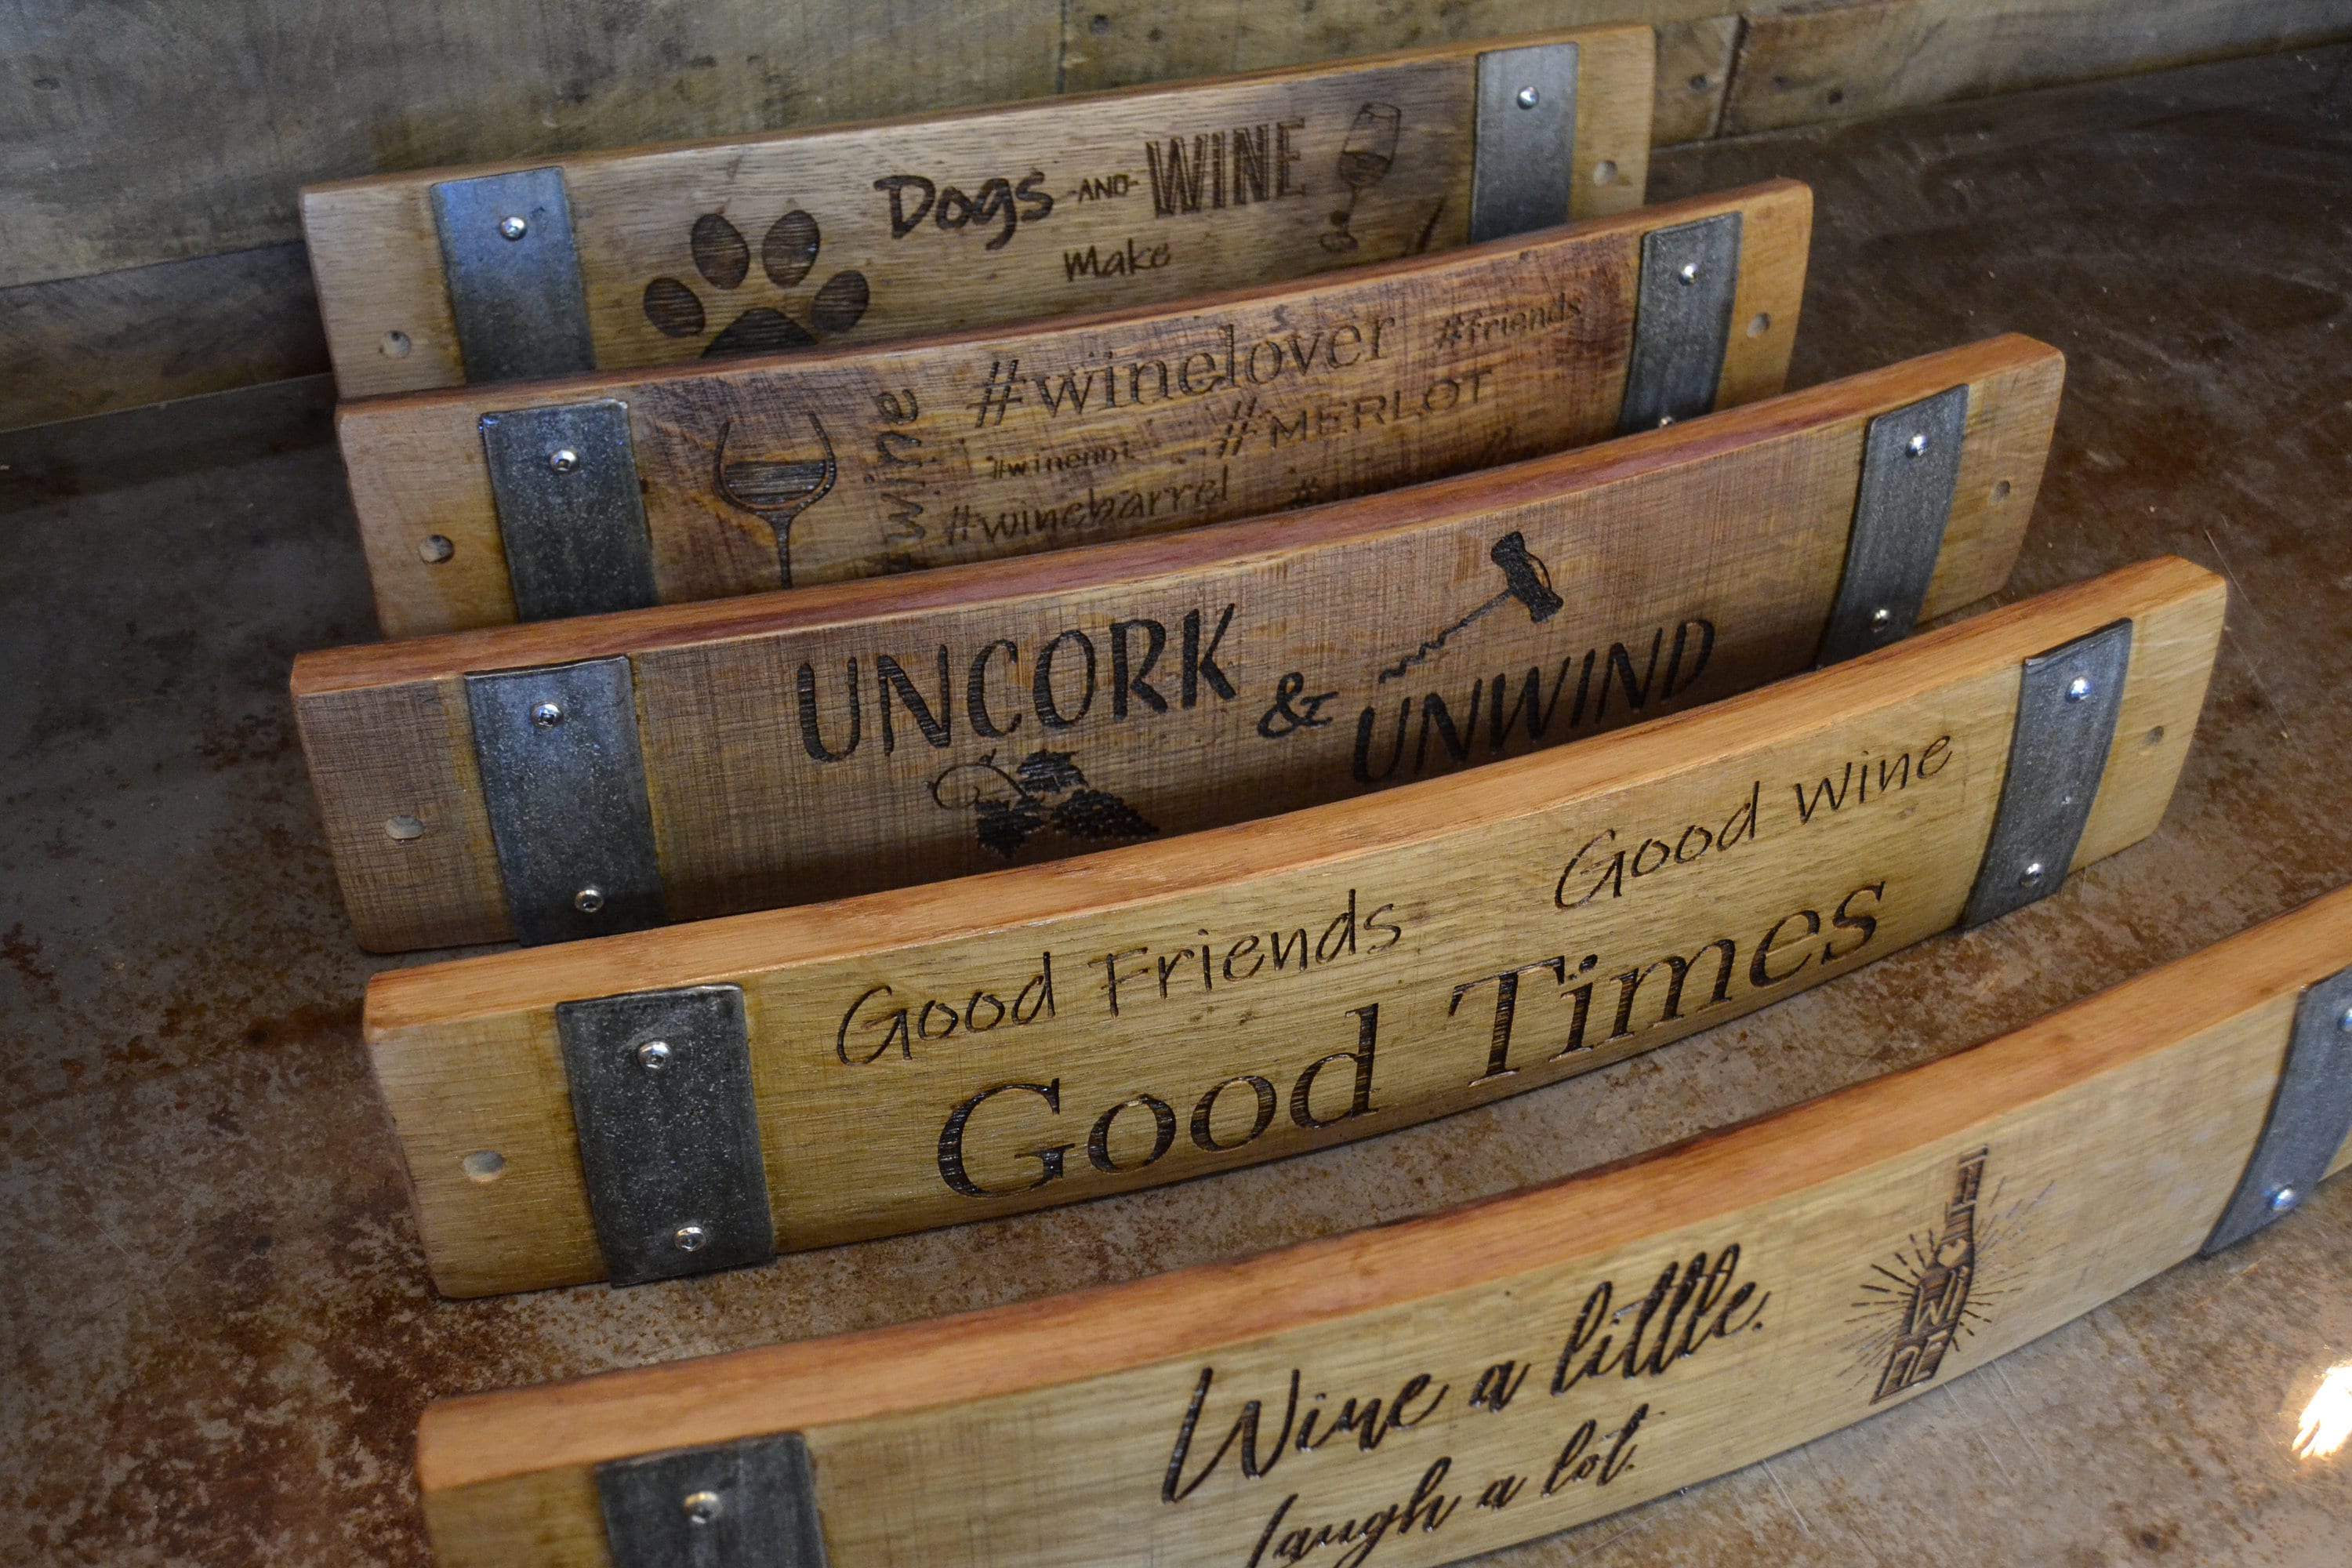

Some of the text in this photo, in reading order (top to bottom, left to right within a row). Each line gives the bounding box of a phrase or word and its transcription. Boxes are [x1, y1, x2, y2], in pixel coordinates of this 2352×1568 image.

[873, 167, 1054, 251] Dogs
[1145, 118, 1307, 218] WINE
[966, 314, 1396, 428] #winelover
[1435, 292, 1581, 350] #friends
[1214, 368, 1492, 459] #MERLOT
[946, 464, 1229, 546] #winebarrel
[797, 603, 1237, 764] UNCORK
[1257, 618, 1716, 784] & UNWIND
[837, 949, 1057, 1067] Good
[1087, 887, 1403, 1019] Friends
[1553, 779, 1760, 911] Good
[937, 881, 1886, 1200] Good Times
[1162, 1367, 1449, 1504] Wine
[1468, 1358, 1531, 1412] a
[1477, 1476, 1526, 1511] a
